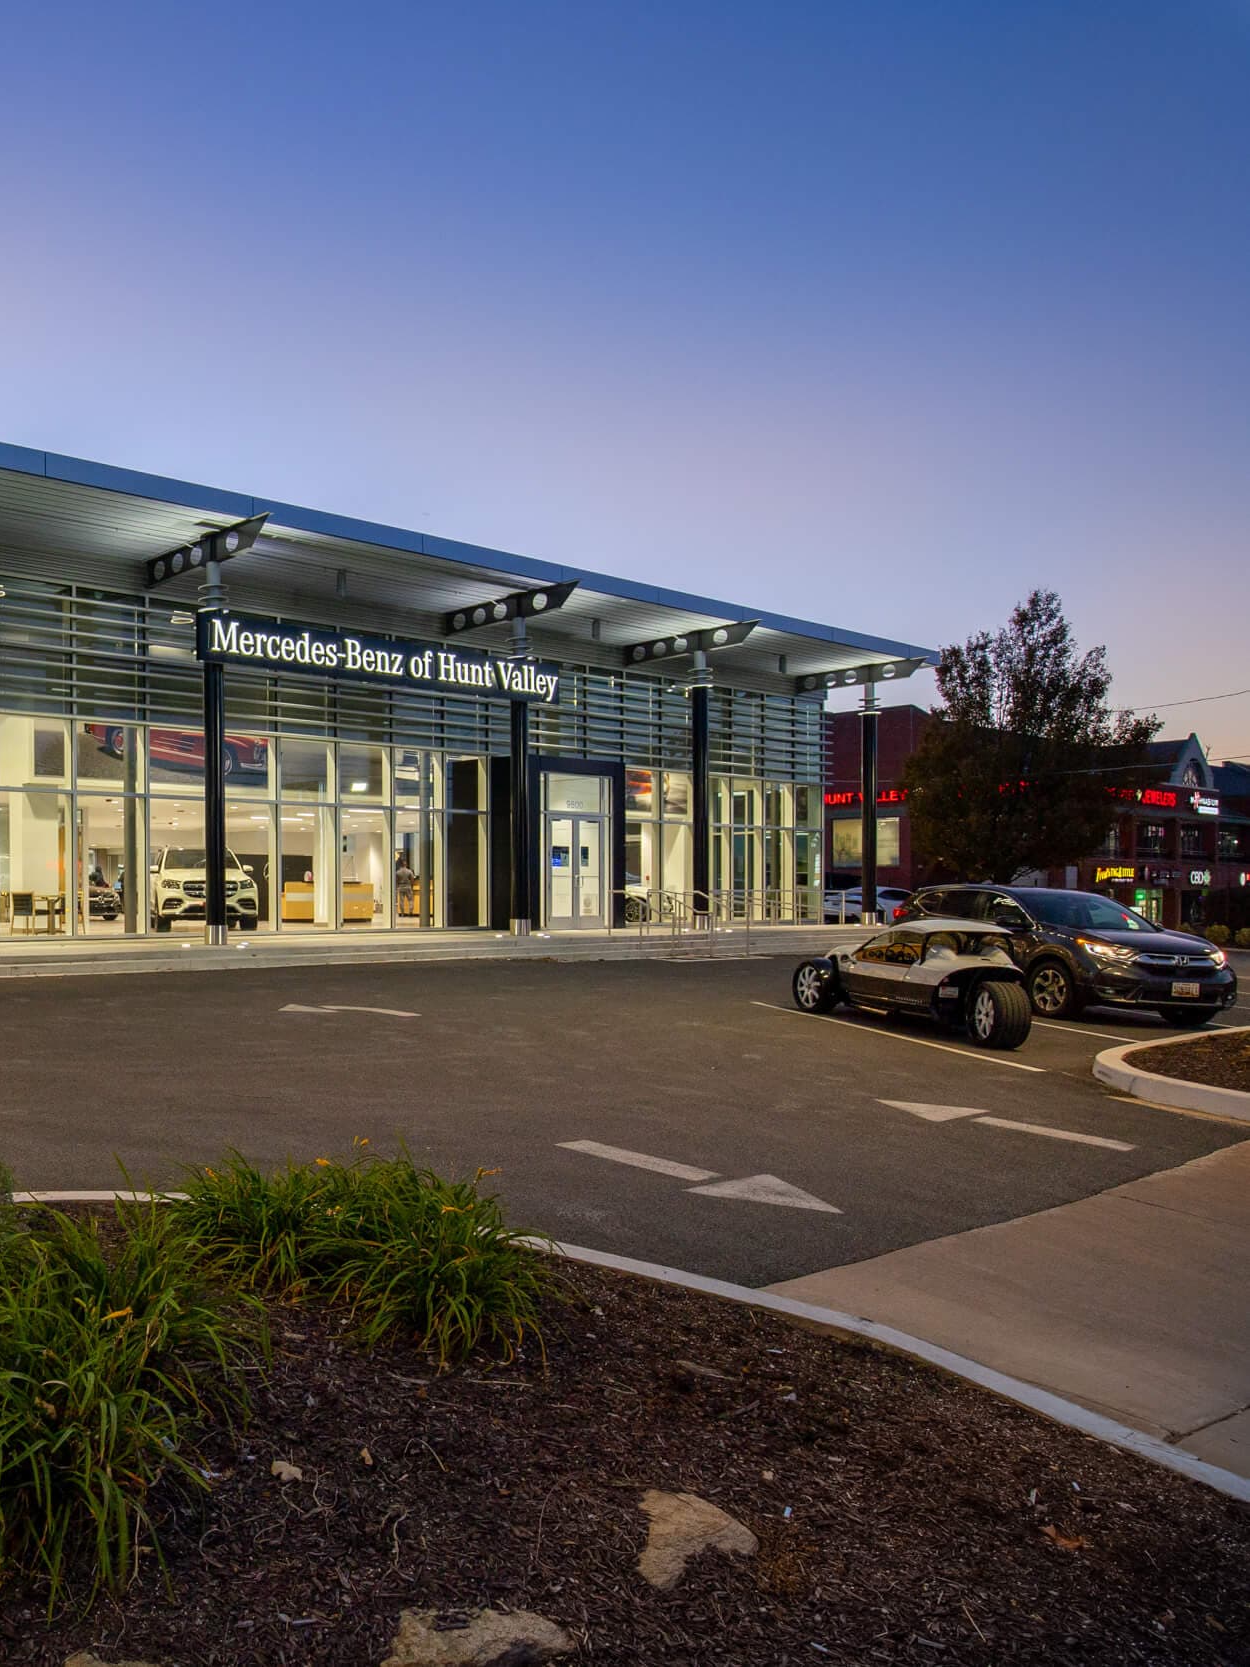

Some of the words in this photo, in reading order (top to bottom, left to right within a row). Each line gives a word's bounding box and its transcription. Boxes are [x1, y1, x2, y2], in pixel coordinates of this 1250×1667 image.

[211, 619, 404, 676] Mercedes-Benz
[409, 650, 434, 679] of
[437, 652, 493, 688] Hunt
[496, 661, 559, 703] Valley
[1190, 870, 1204, 885] CBD
